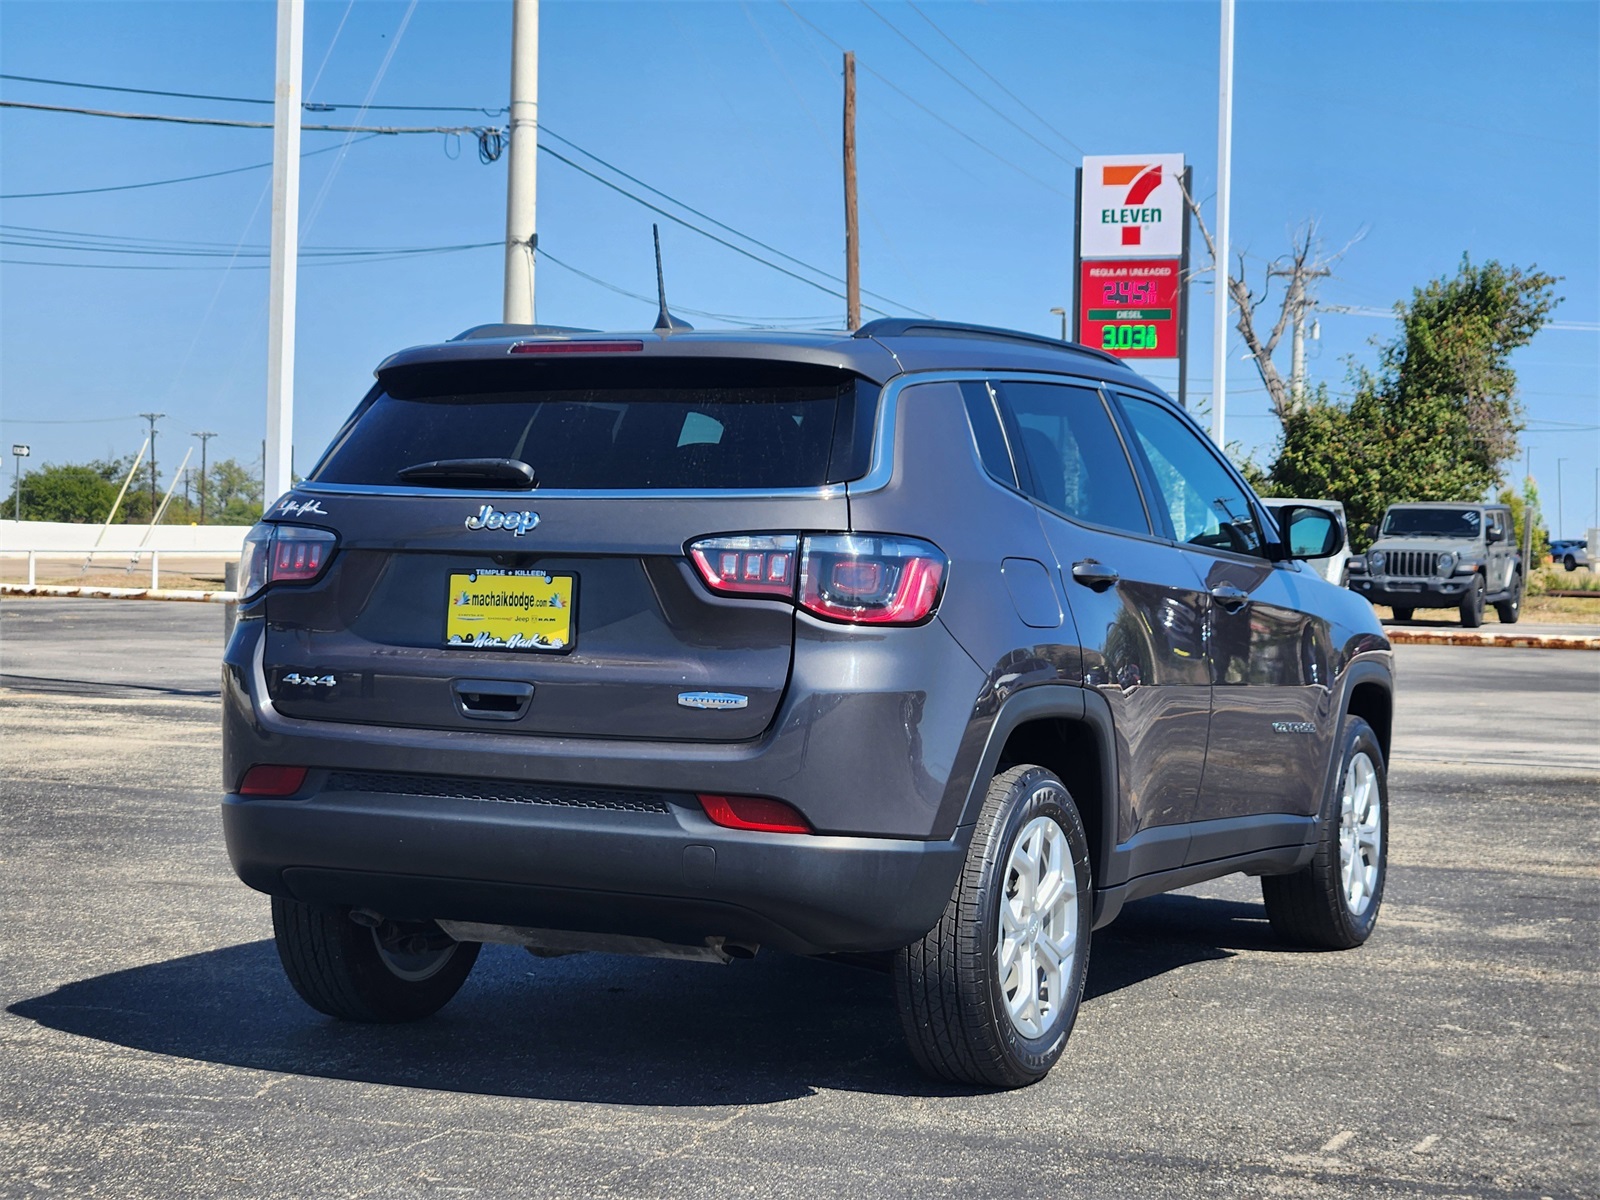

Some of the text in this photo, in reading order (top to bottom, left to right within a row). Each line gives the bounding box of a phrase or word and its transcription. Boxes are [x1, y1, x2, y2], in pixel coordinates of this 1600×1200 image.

[1090, 267, 1171, 277] REGULAR UNLEADED
[1116, 310, 1143, 319] DIESEL
[466, 505, 540, 537] Jeep
[472, 591, 548, 611] machaikdodge.com
